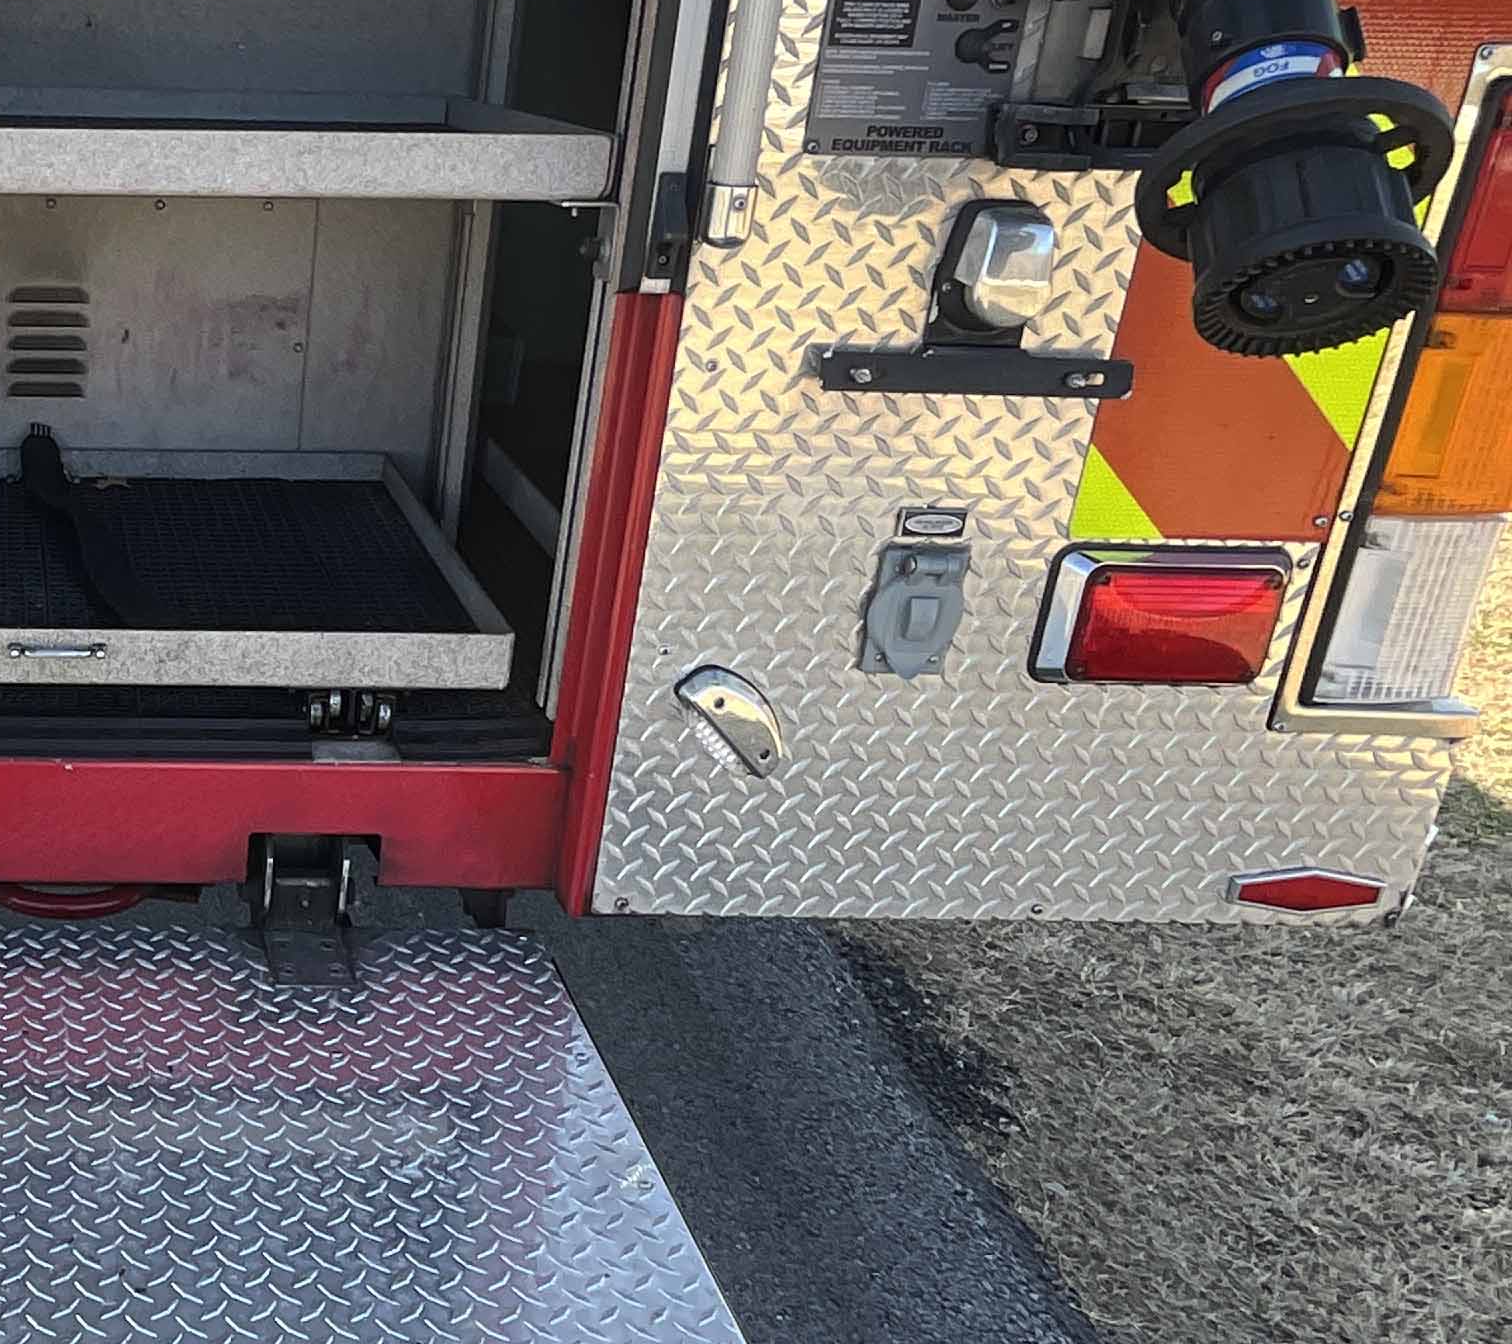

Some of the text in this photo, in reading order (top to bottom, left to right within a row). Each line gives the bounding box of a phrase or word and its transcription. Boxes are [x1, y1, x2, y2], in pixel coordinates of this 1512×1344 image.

[1254, 61, 1290, 78] FOG
[867, 126, 944, 138] POWERED
[831, 139, 972, 154] EQUIPMENT RACK
